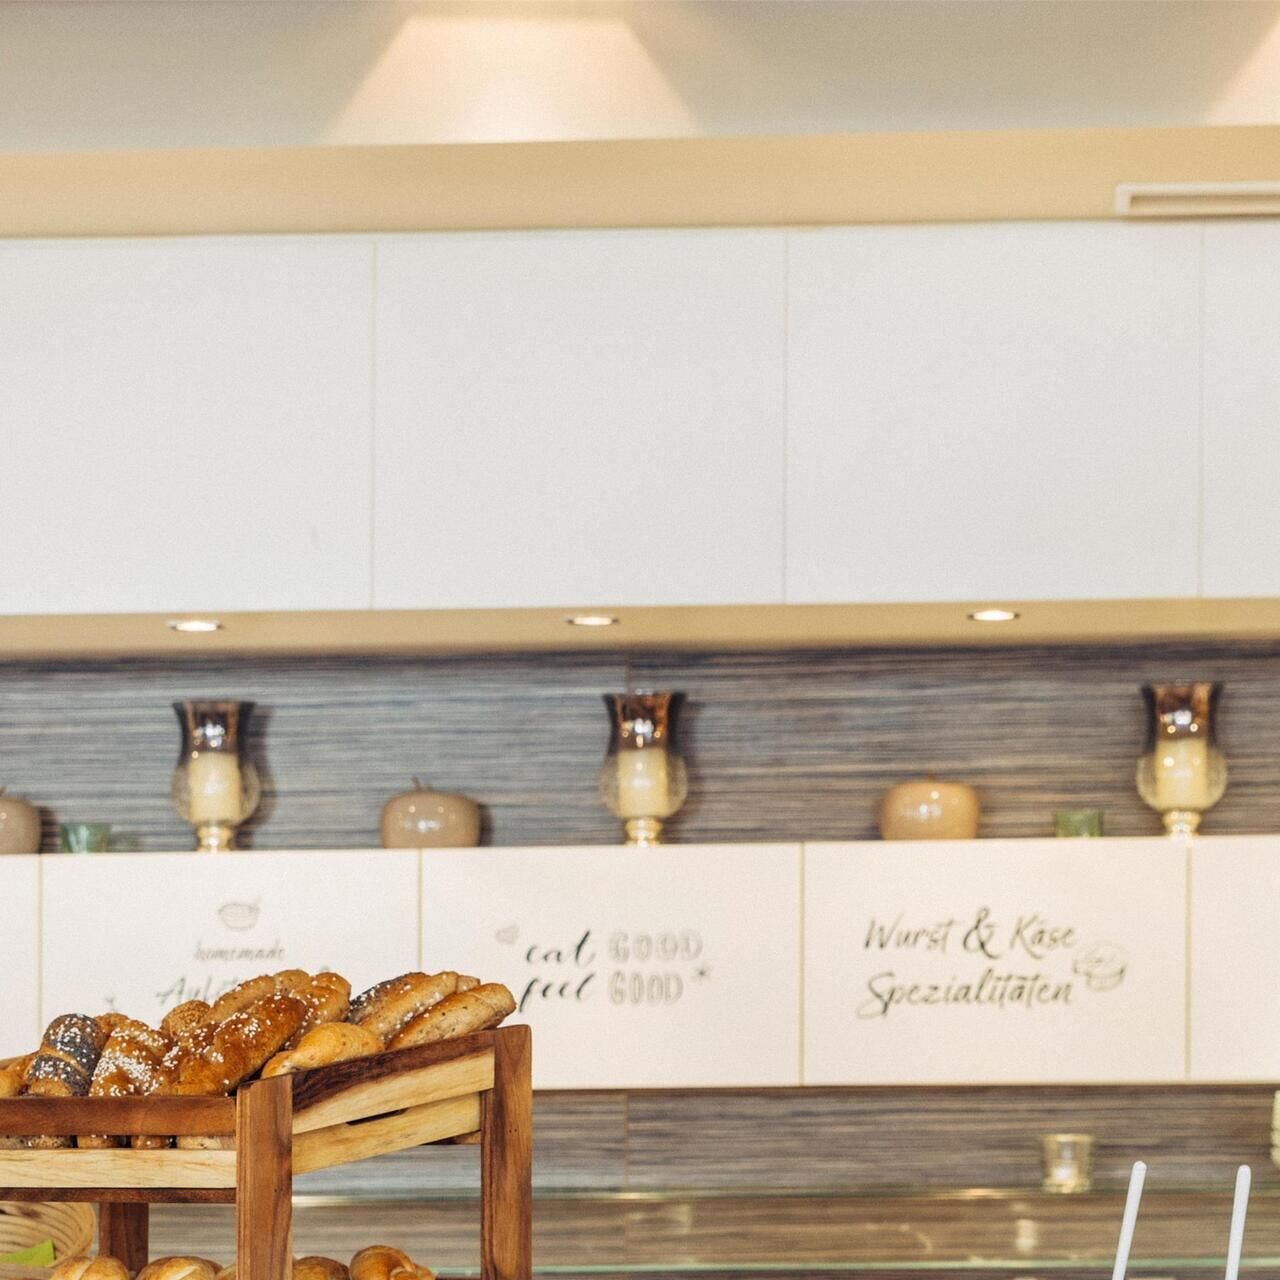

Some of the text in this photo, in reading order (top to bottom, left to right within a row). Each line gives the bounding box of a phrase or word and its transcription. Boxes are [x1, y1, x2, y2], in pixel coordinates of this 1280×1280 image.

[194, 939, 286, 962] homemade
[525, 929, 703, 966] eat GOOD
[864, 906, 1075, 960] Wurst & Käse
[518, 971, 683, 1013] feel GOOD
[856, 967, 1073, 1020] Spezialitäten
